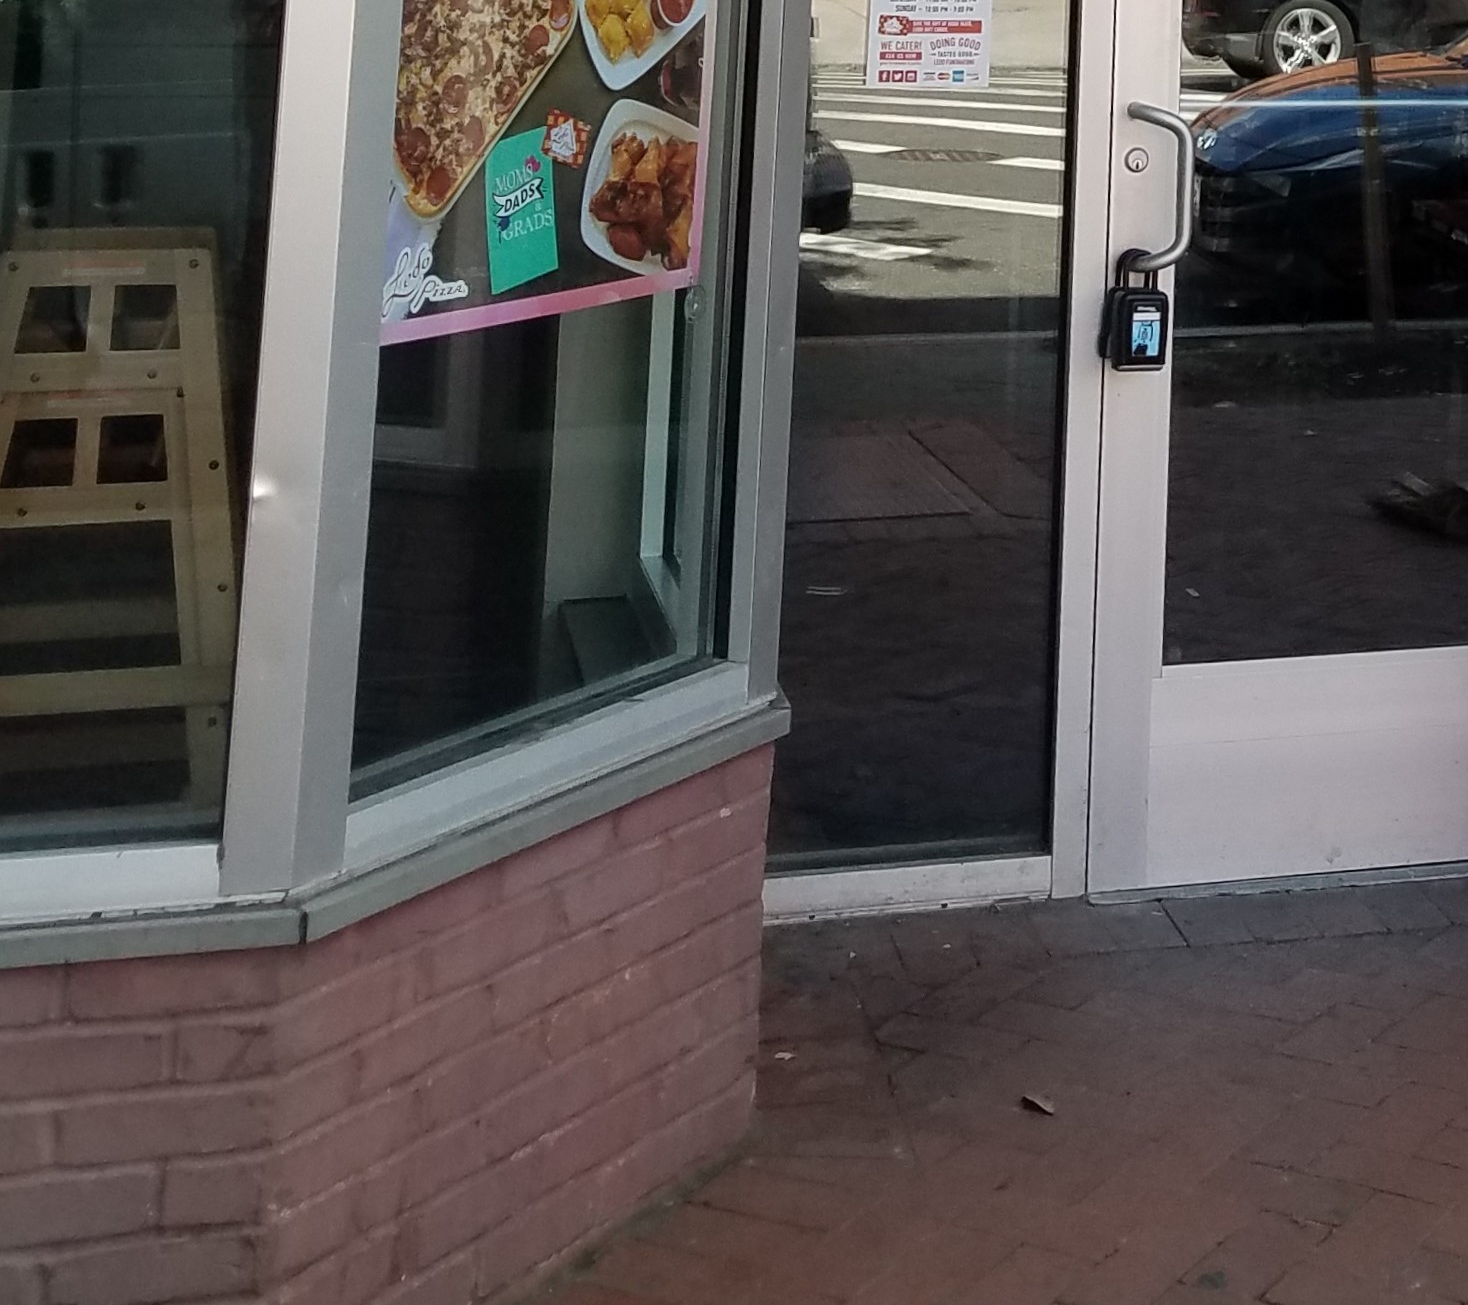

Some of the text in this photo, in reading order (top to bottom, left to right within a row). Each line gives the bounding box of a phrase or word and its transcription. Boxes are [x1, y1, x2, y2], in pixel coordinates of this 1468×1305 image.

[880, 41, 893, 50] WE
[930, 37, 981, 50] DOING GOOD
[495, 163, 534, 193] MOMS
[504, 182, 537, 213] DADS
[502, 208, 554, 241] GRADS
[381, 246, 430, 318] Ledo
[413, 279, 463, 309] Pizza
